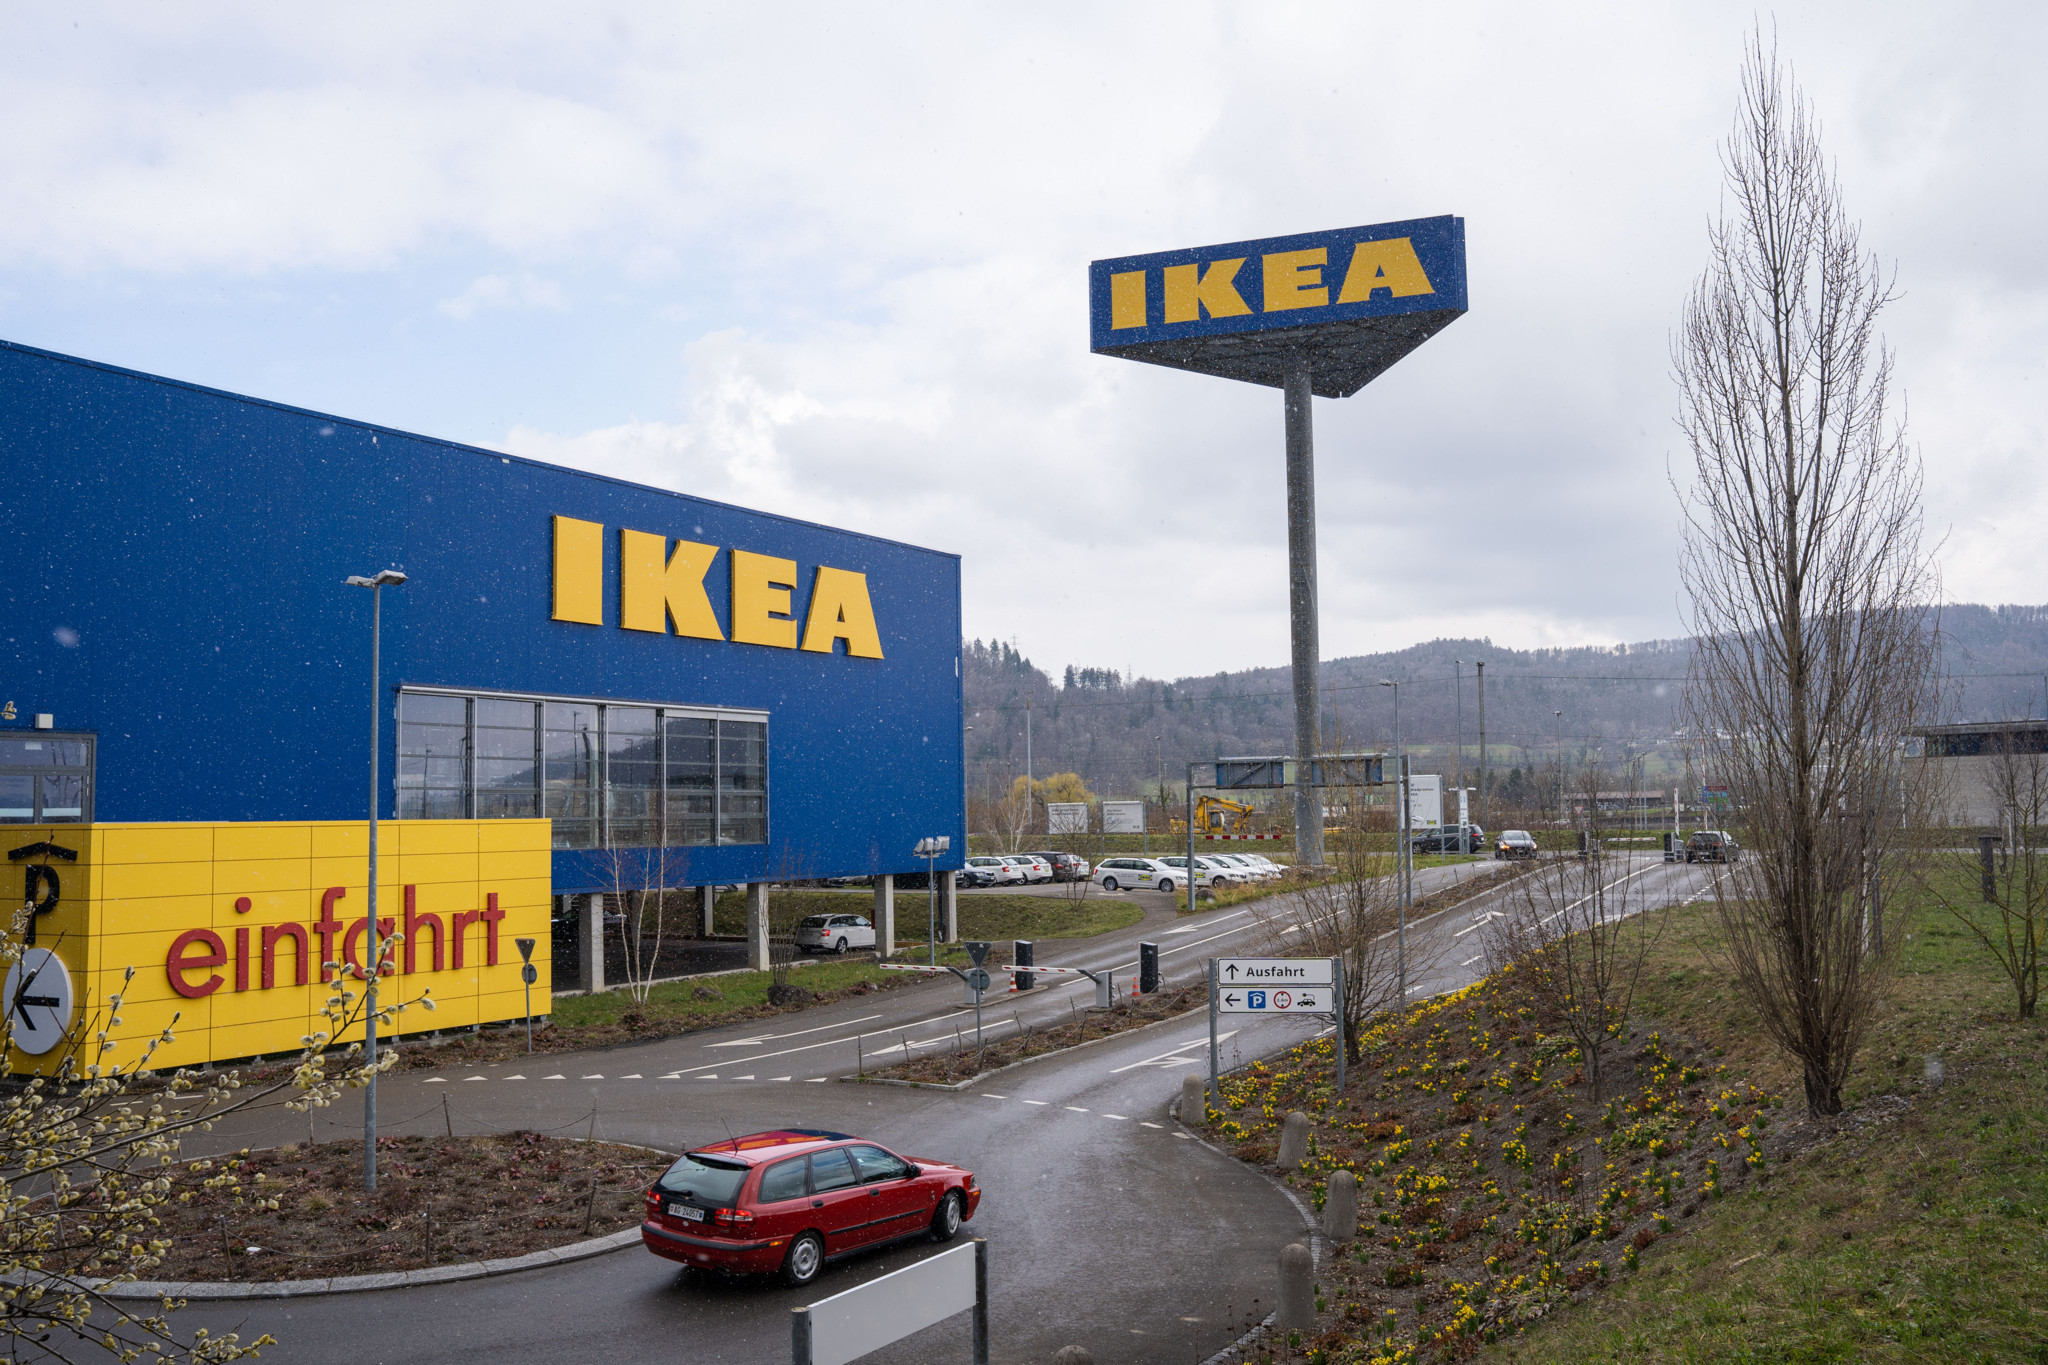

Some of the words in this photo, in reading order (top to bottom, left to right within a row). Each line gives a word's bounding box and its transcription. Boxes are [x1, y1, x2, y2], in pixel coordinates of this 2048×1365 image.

[1111, 237, 1435, 330] IKEA
[552, 515, 885, 659] IKEA
[166, 885, 506, 998] einfahrt
[1246, 966, 1305, 977] Ausfahrt
